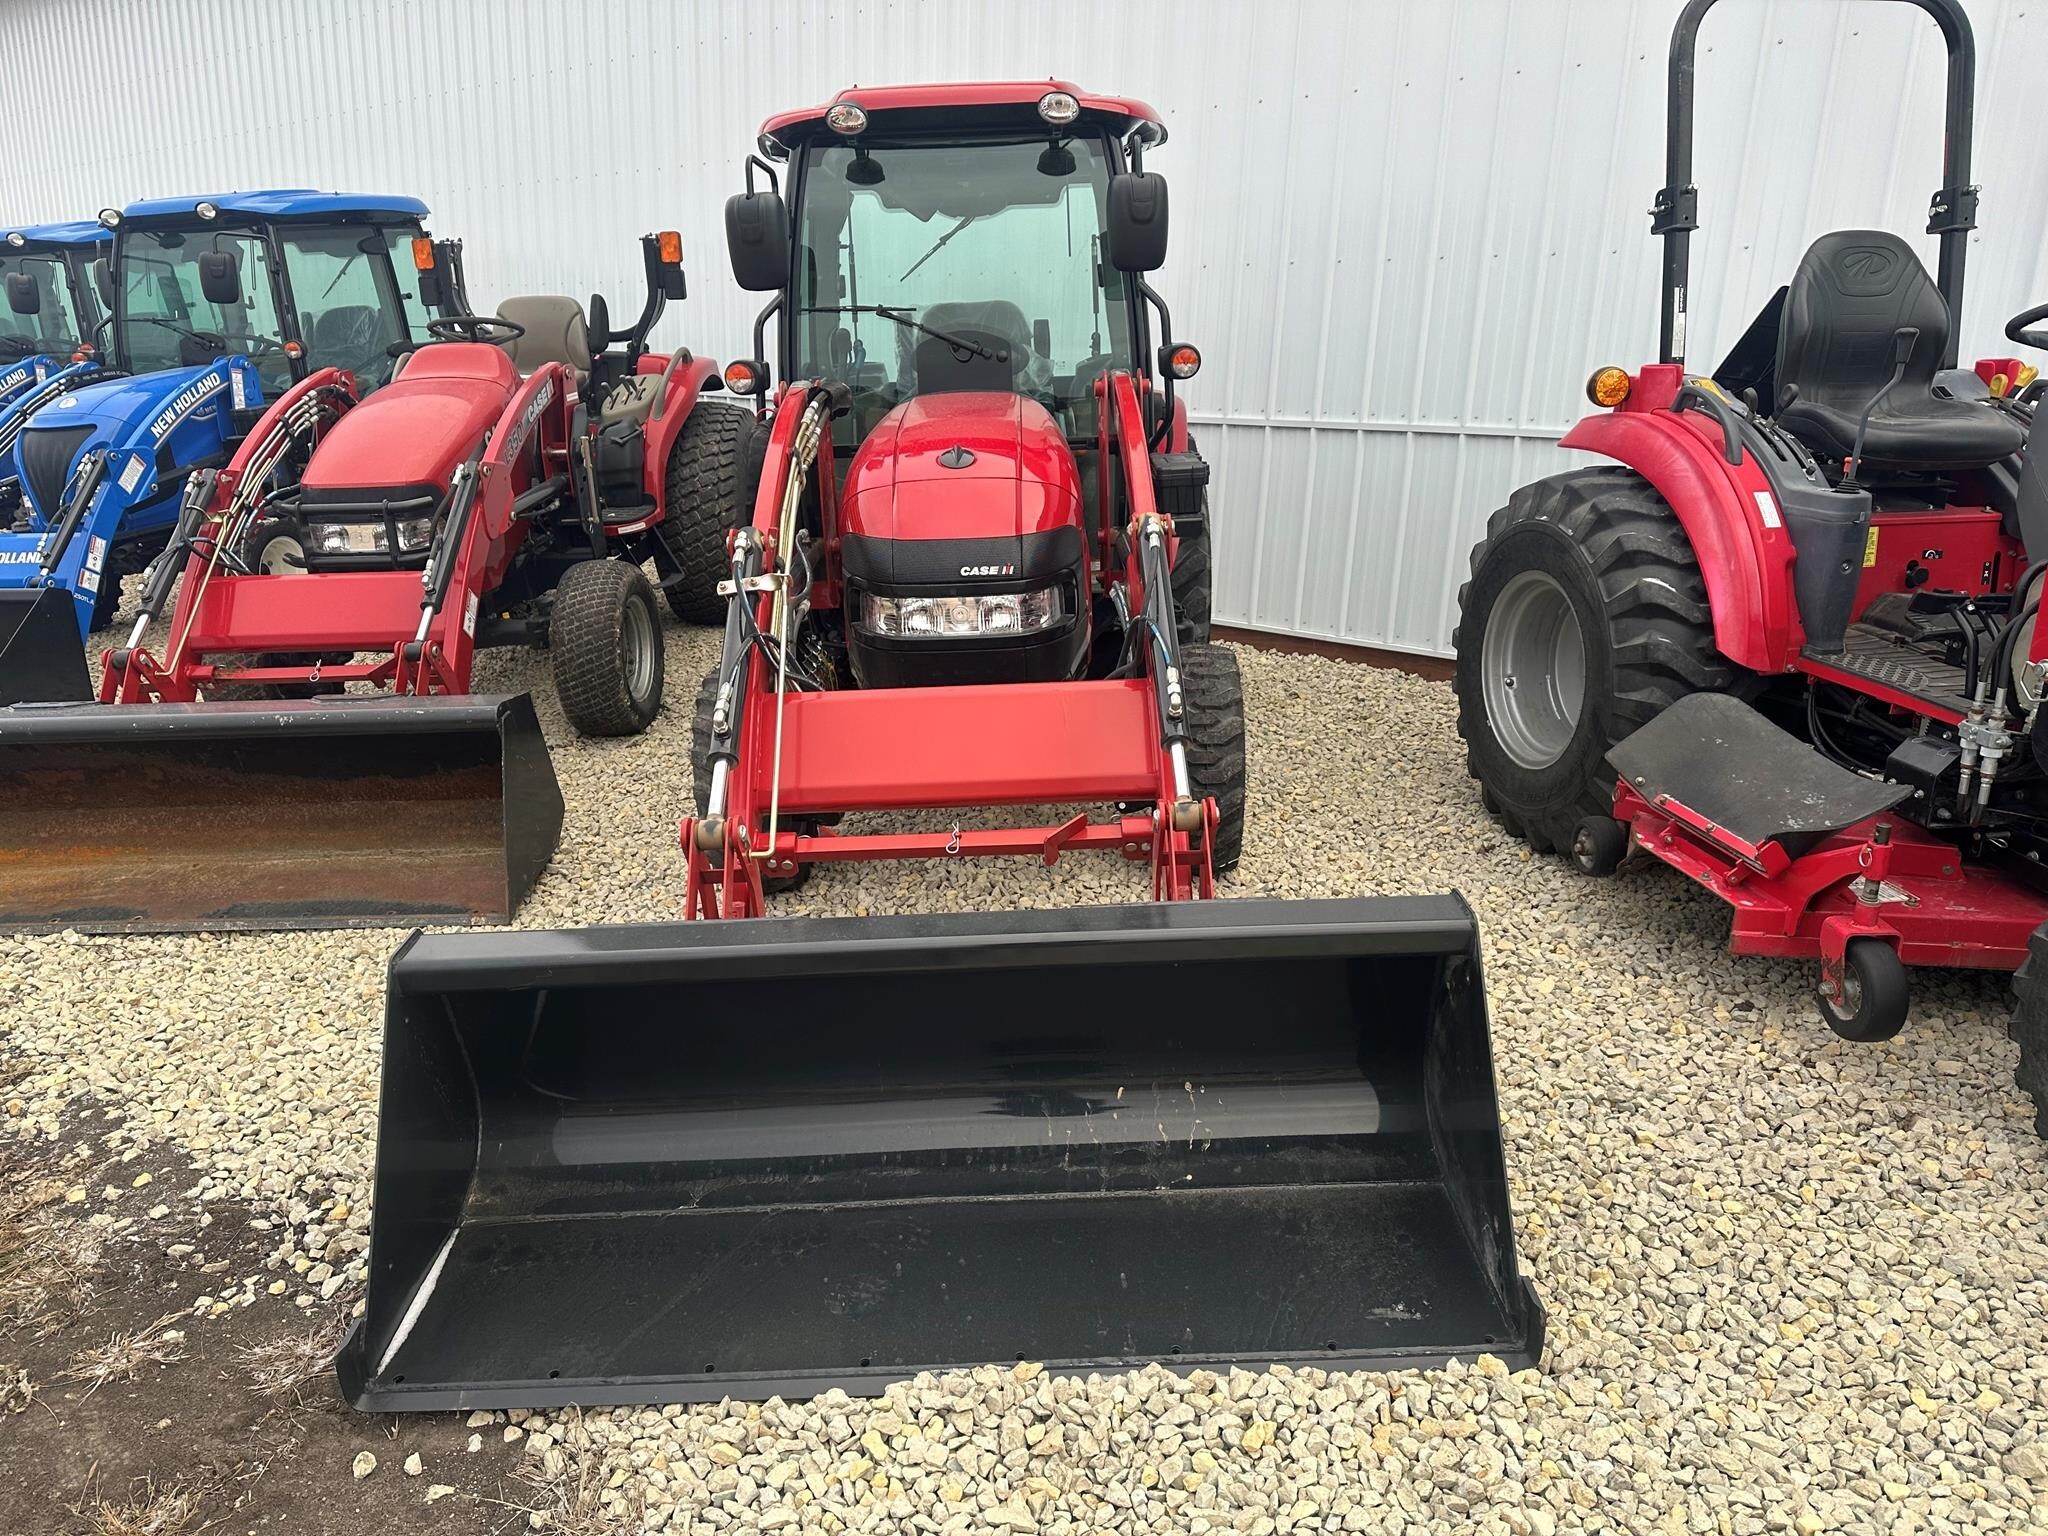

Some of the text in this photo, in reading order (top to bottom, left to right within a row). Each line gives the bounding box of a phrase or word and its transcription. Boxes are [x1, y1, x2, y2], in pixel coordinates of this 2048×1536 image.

[150, 407, 177, 439] NEW
[172, 372, 221, 415] HOLLAND
[960, 565, 999, 577] CASE
